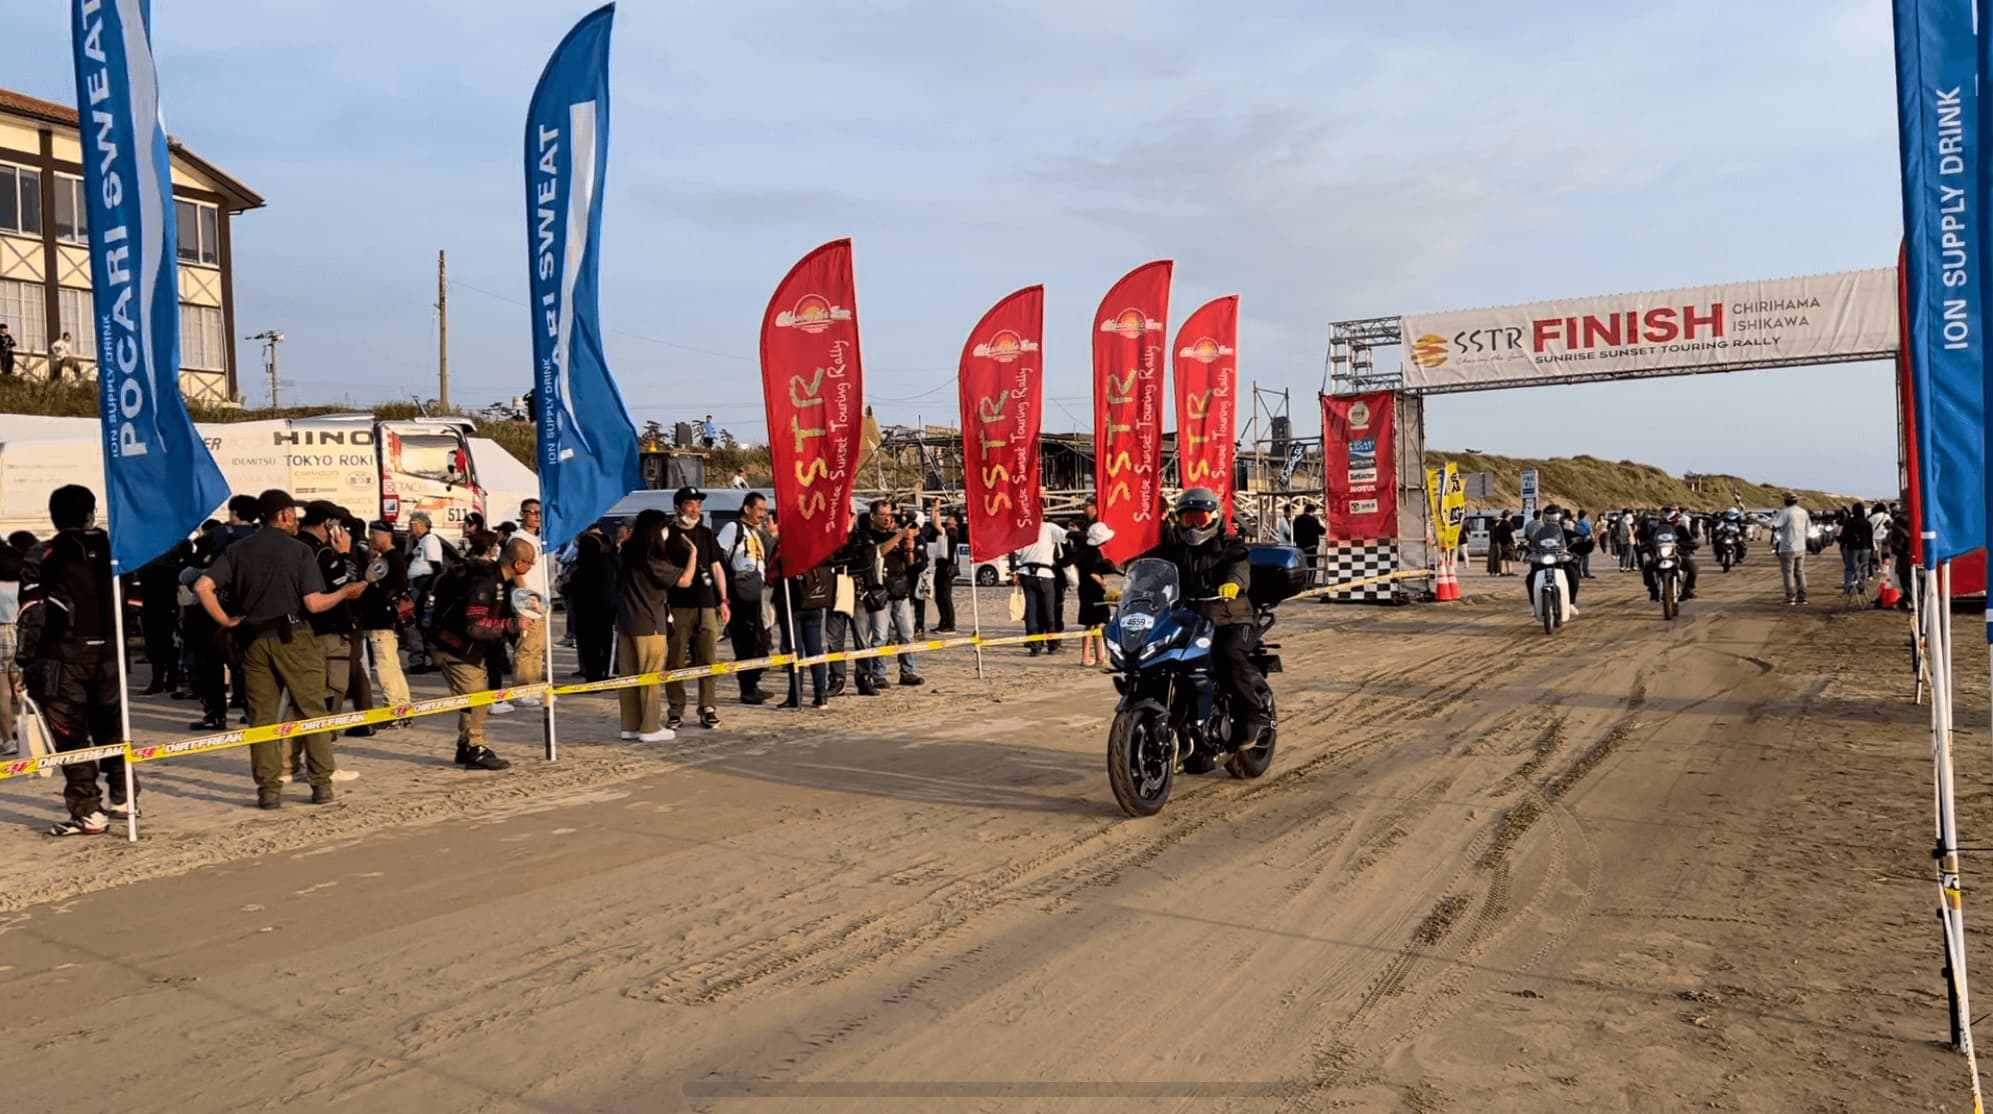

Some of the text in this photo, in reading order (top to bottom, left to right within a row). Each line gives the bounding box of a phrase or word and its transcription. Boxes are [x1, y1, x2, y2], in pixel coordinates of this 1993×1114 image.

[81, 0, 148, 457] POCARI SWEAT
[537, 124, 560, 281] SWEAT
[1935, 86, 1969, 351] ION SUPPLY DRINK
[1454, 326, 1523, 354] SSTR
[1533, 302, 1725, 353] FINISH
[1732, 297, 1822, 315] CHIRIHAMA
[1732, 315, 1810, 332] ISHIKAWA
[101, 314, 119, 458] ION SUPPLY DRINK
[826, 340, 849, 379] Rally
[1536, 336, 1782, 364] SUNRISE SUNSET TOURING RALLY
[273, 430, 375, 446] HINO
[541, 357, 557, 465] ION SUPPLY DRINK
[790, 367, 828, 521] SSTR
[831, 381, 850, 434] Touring
[1106, 368, 1138, 508] SSTR
[1133, 345, 1160, 523] Sunrise Sunset Touring Rally
[1187, 388, 1214, 483] STR
[1211, 366, 1233, 480] Sunset Touring Rally
[230, 456, 277, 466] IDEMITSU
[283, 454, 374, 467] TOKYO ROKI
[830, 436, 848, 481] Sunset
[979, 389, 1012, 517] SSTR
[1010, 367, 1033, 529] Sunrise Sunset Touring Rally
[447, 507, 468, 522] 511
